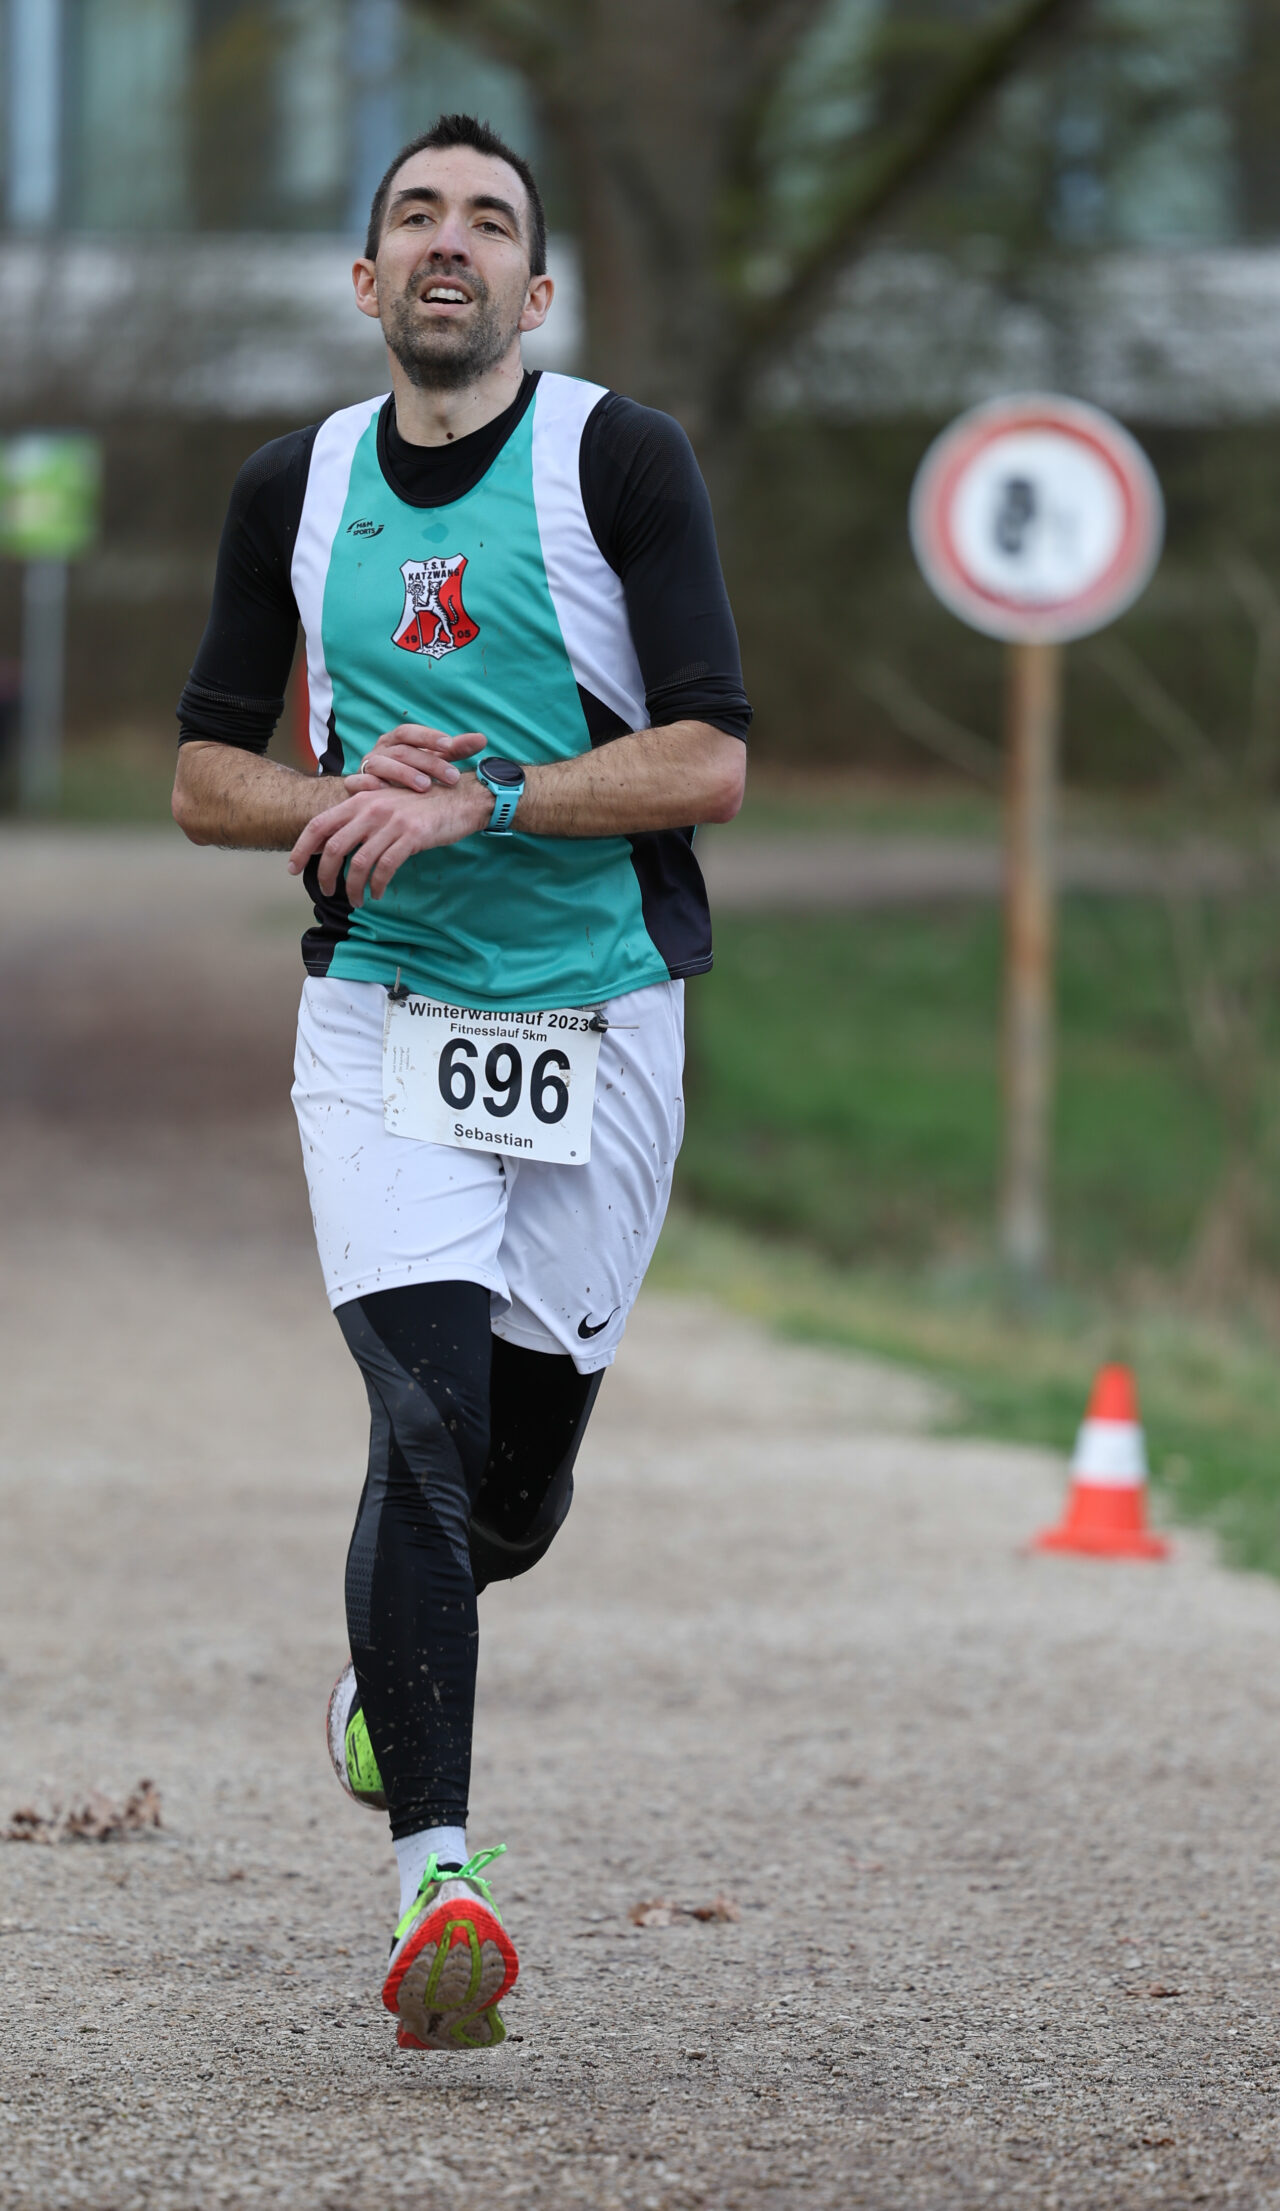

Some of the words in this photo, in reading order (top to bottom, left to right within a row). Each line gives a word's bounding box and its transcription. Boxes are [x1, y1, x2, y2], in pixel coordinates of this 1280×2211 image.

[353, 528, 375, 536] SPORTS
[408, 568, 460, 581] KATZWANG
[405, 635, 418, 644] 19
[457, 629, 471, 639] 05
[547, 1013, 589, 1032] 2023
[450, 1023, 520, 1039] Fitnesslauf
[522, 1029, 548, 1042] 5km
[438, 1037, 571, 1124] 696
[454, 1123, 533, 1149] Sebastian
